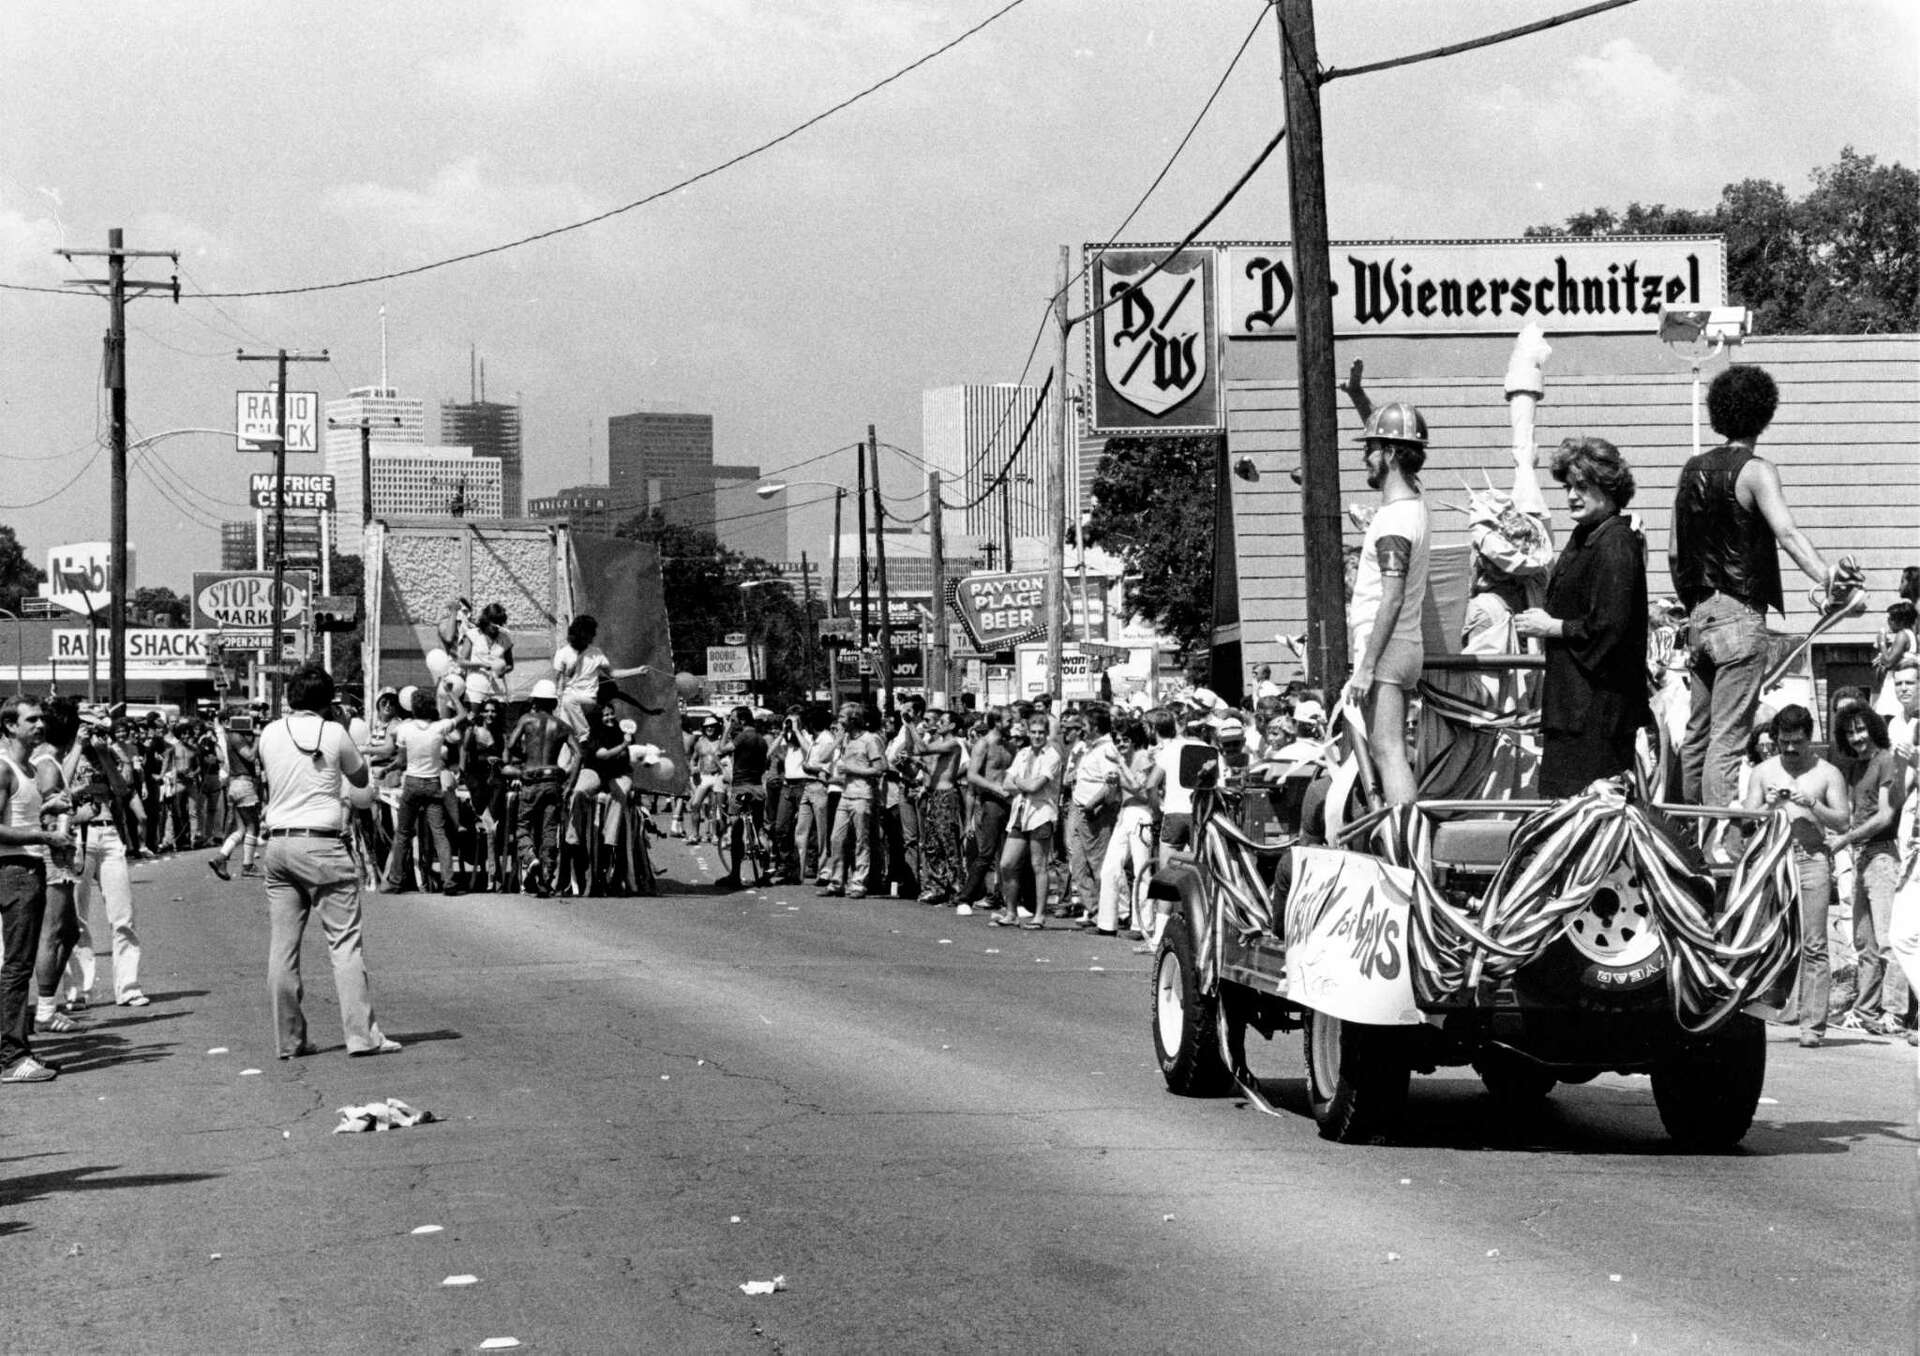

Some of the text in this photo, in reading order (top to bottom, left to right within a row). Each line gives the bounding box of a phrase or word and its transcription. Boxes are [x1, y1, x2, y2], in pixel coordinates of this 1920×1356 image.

[1348, 253, 1700, 325] Wienerschnitzel
[247, 396, 308, 420] RAIO
[245, 423, 312, 447] SCK
[53, 555, 112, 595] Mbi
[970, 577, 1044, 596] PAYTON
[208, 580, 259, 608] STOP
[975, 591, 1043, 610] PLACE
[980, 608, 1034, 630] BEER
[58, 634, 200, 656] RAI SHACK
[223, 636, 248, 648] OPEN
[248, 636, 260, 648] 24
[1350, 885, 1402, 981] GAYS
